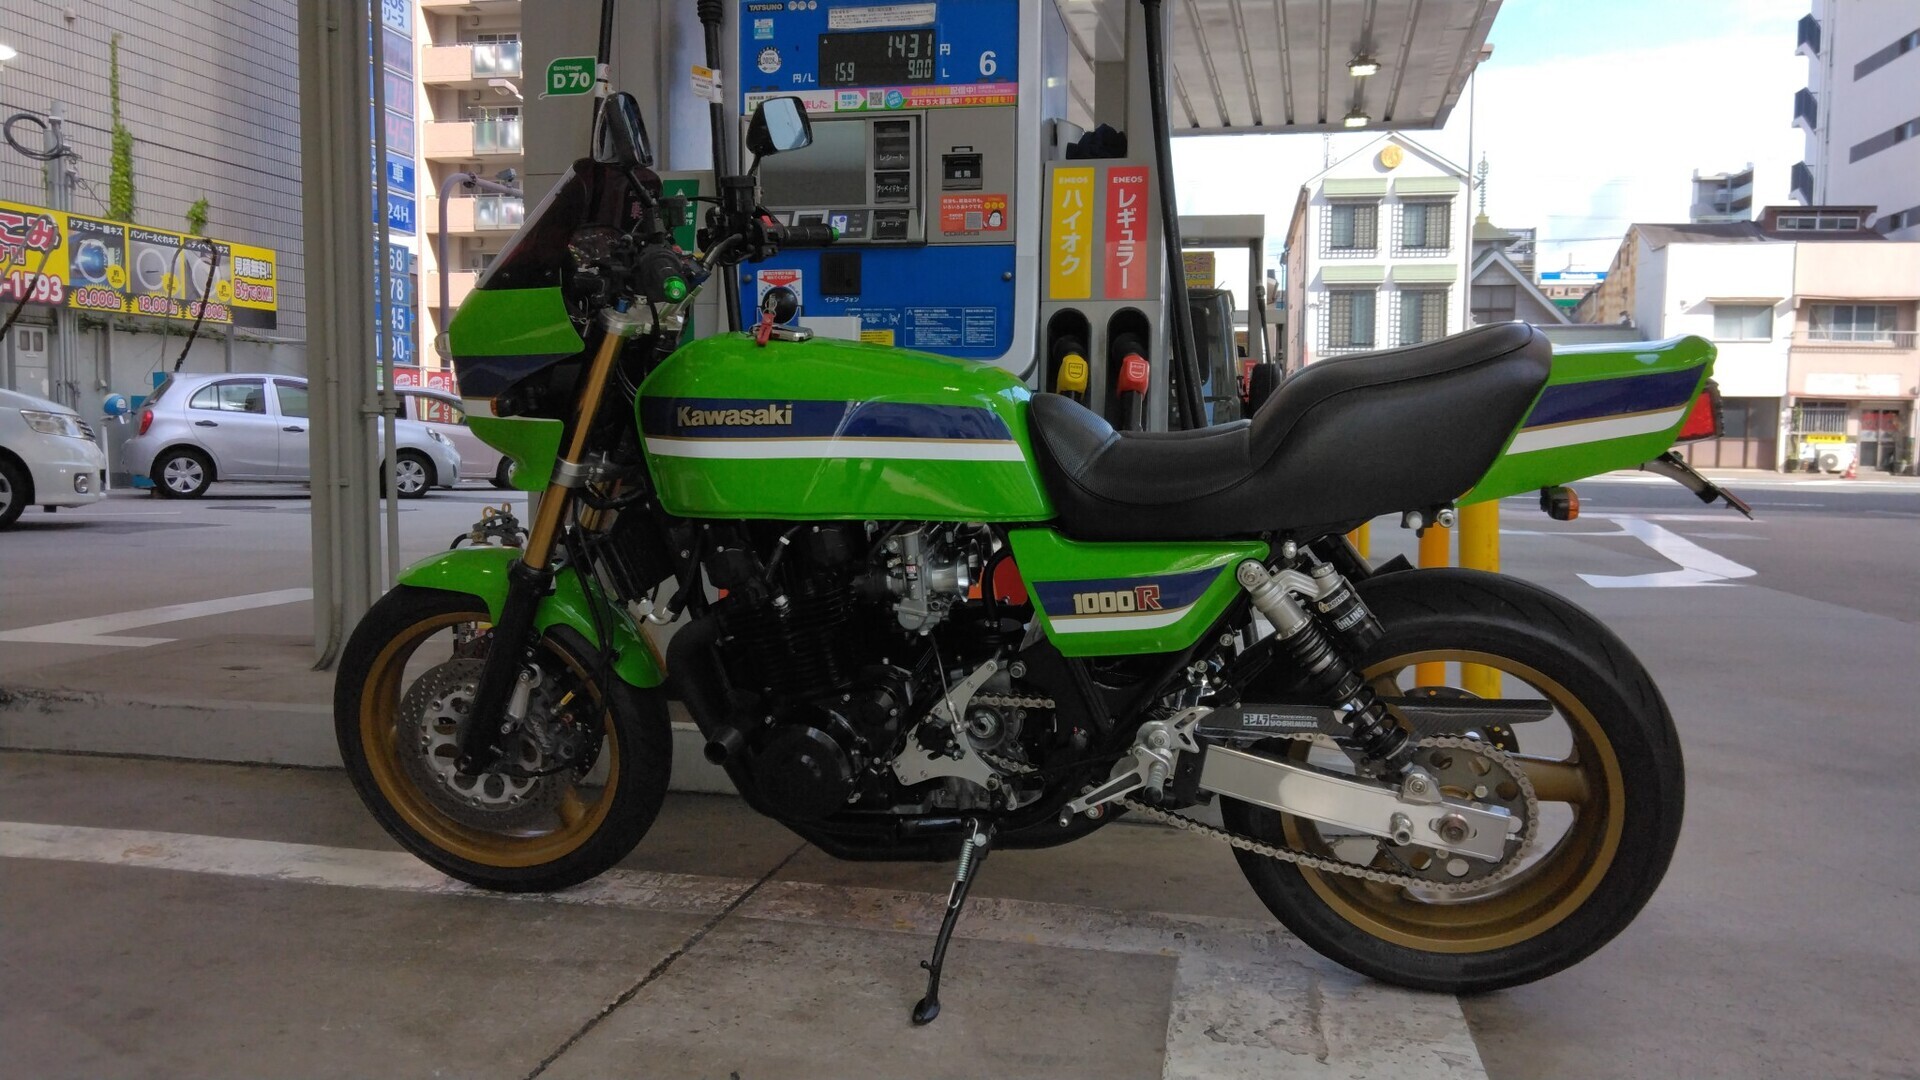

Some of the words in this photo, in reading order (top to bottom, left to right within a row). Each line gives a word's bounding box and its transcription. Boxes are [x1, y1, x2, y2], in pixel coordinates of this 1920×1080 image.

[888, 33, 933, 58] 1431
[940, 44, 950, 55] 円
[835, 62, 855, 82] 159
[942, 69, 950, 77] L
[979, 50, 997, 76] 6
[792, 73, 815, 83] 円/L
[880, 153, 905, 161] レシート
[1059, 176, 1088, 184] ENEOS
[1113, 176, 1143, 184] ENEOS
[1062, 189, 1083, 276] ハイオク
[1116, 188, 1137, 290] レギュラー
[677, 404, 793, 427] Kawasaki
[1073, 585, 1162, 615] 1000R
